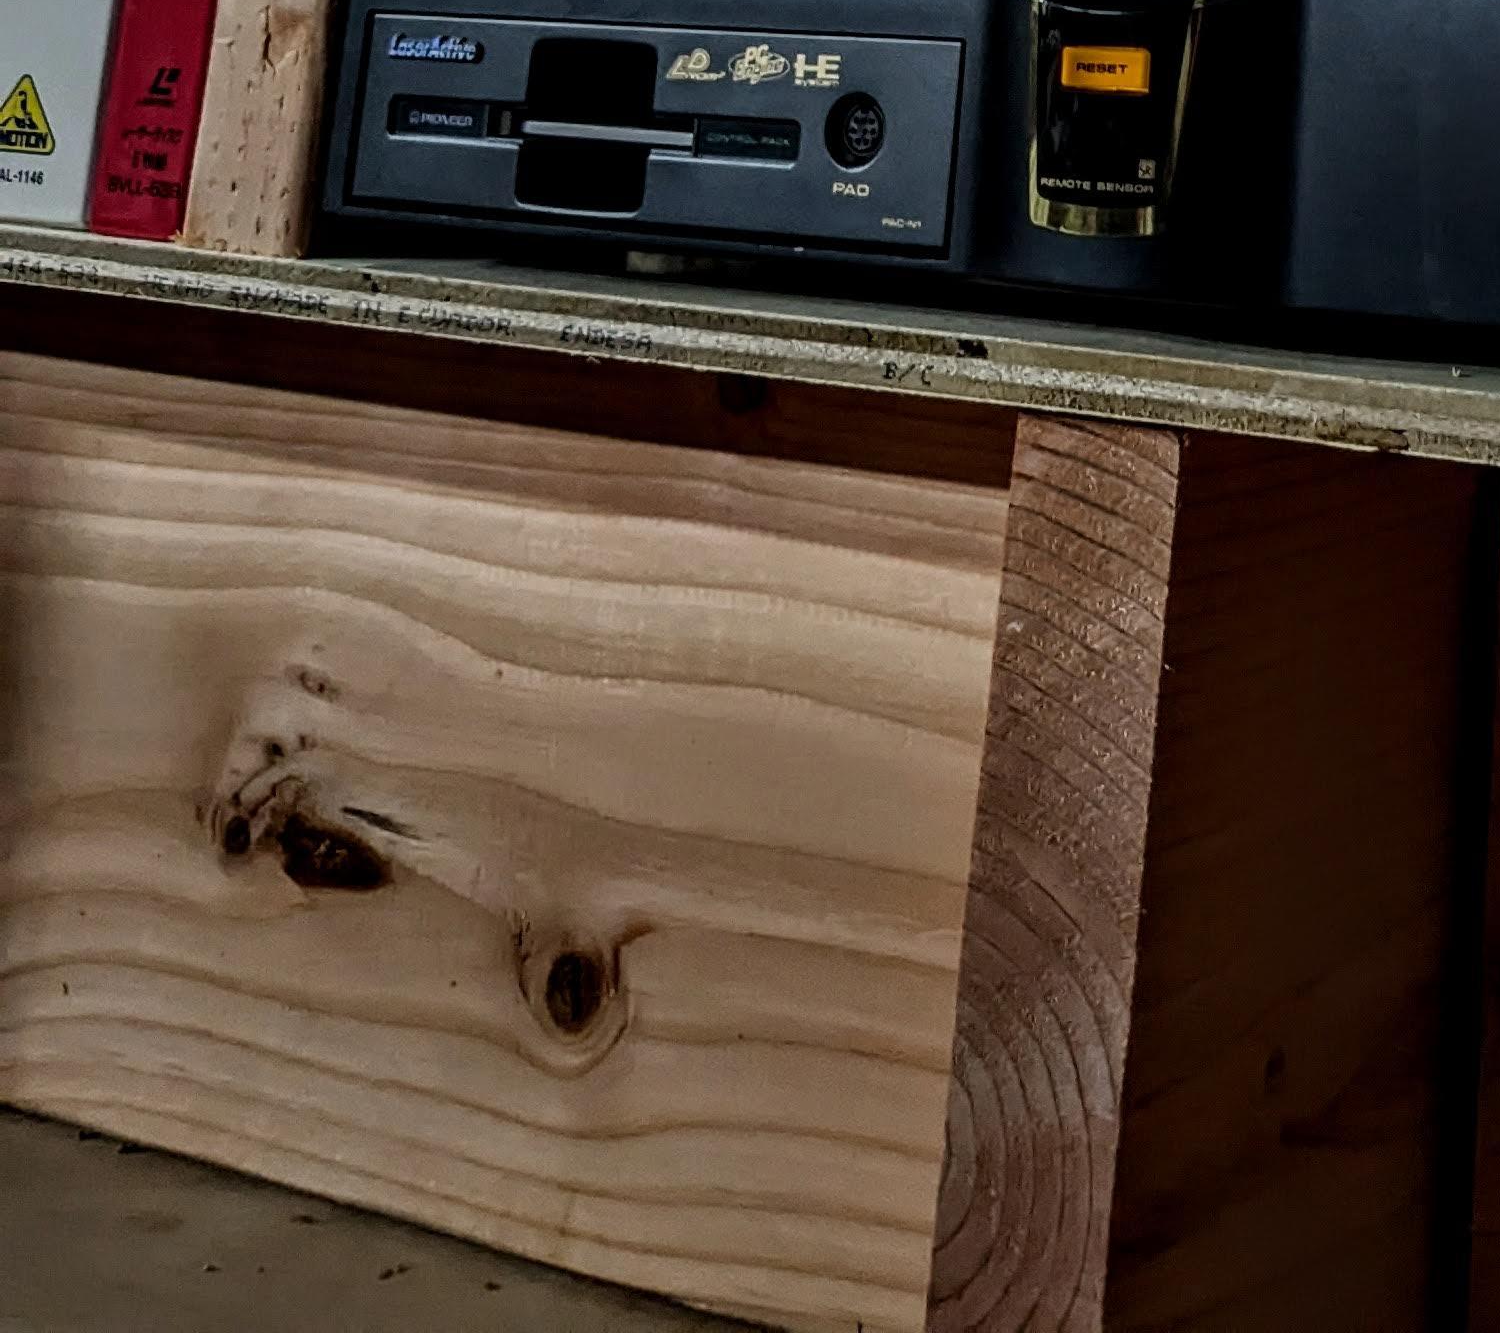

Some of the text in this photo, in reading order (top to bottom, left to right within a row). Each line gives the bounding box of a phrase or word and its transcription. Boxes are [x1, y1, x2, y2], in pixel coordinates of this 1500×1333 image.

[387, 32, 478, 62] LaserActive
[1076, 61, 1129, 75] RESET
[832, 182, 871, 198] PAD
[1040, 177, 1154, 194] REMOTE SENSOR
[559, 324, 653, 353] ENDESA
